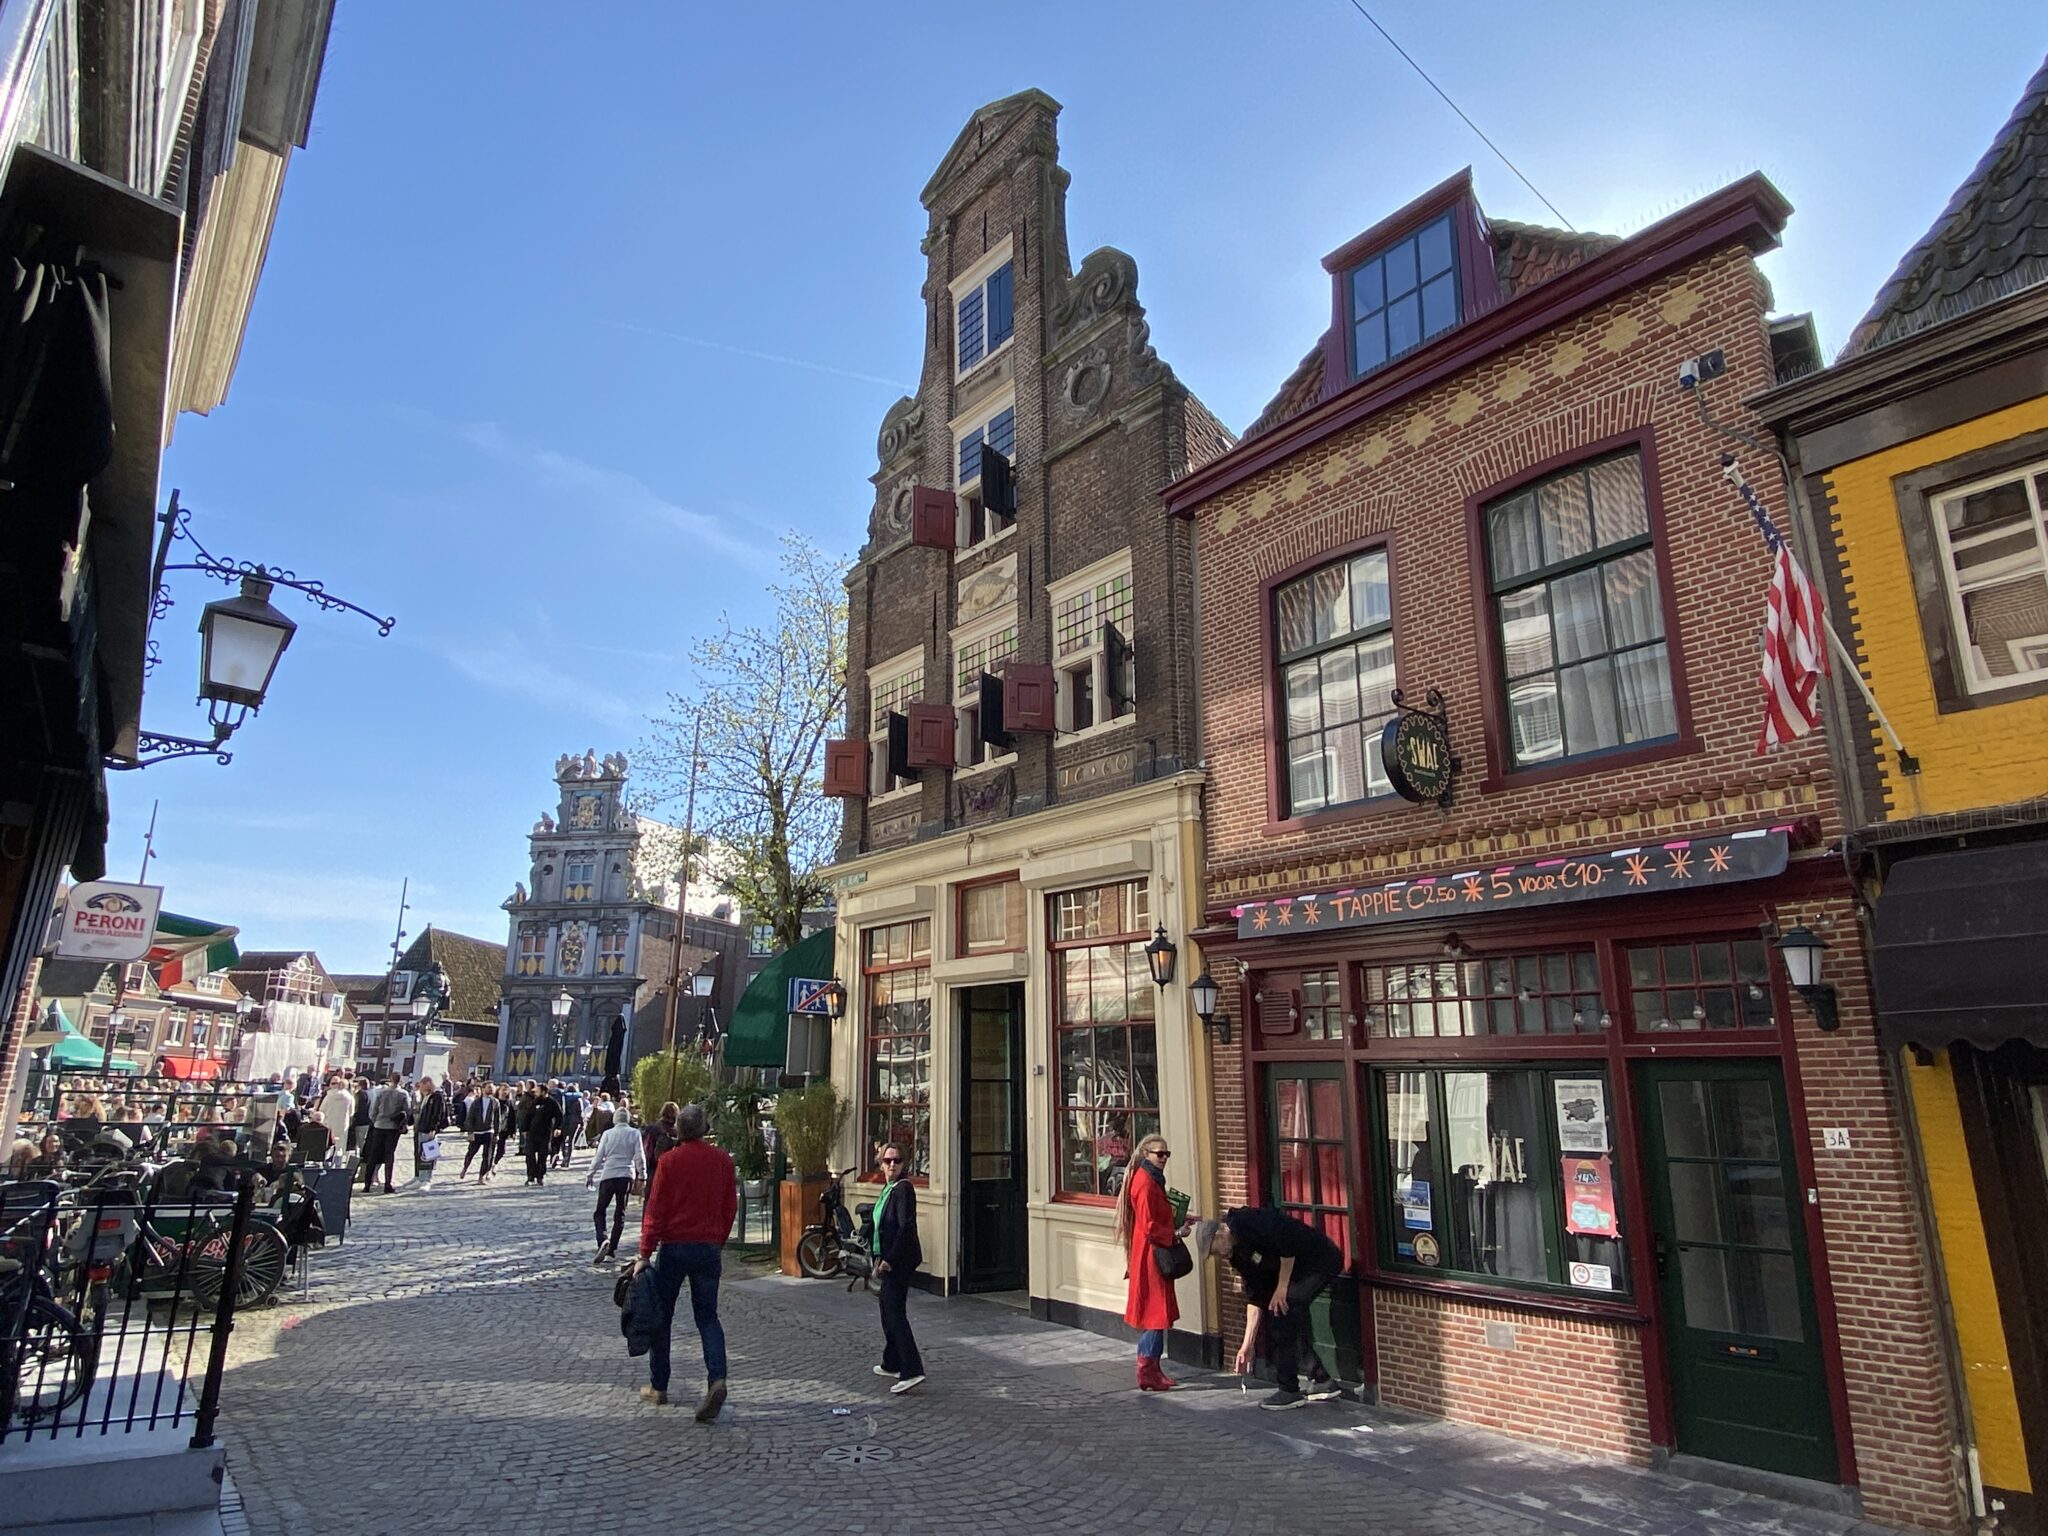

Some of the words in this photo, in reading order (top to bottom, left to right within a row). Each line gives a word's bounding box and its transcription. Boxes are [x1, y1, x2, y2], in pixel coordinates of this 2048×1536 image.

[1329, 888, 1403, 921] TAPPIE
[1490, 871, 1513, 899] 5
[1517, 874, 1558, 894] VOOR
[74, 910, 146, 931] PERONI
[73, 926, 105, 936] NASTRO
[106, 928, 144, 939] AZZURRO
[1828, 1131, 1846, 1145] 3A
